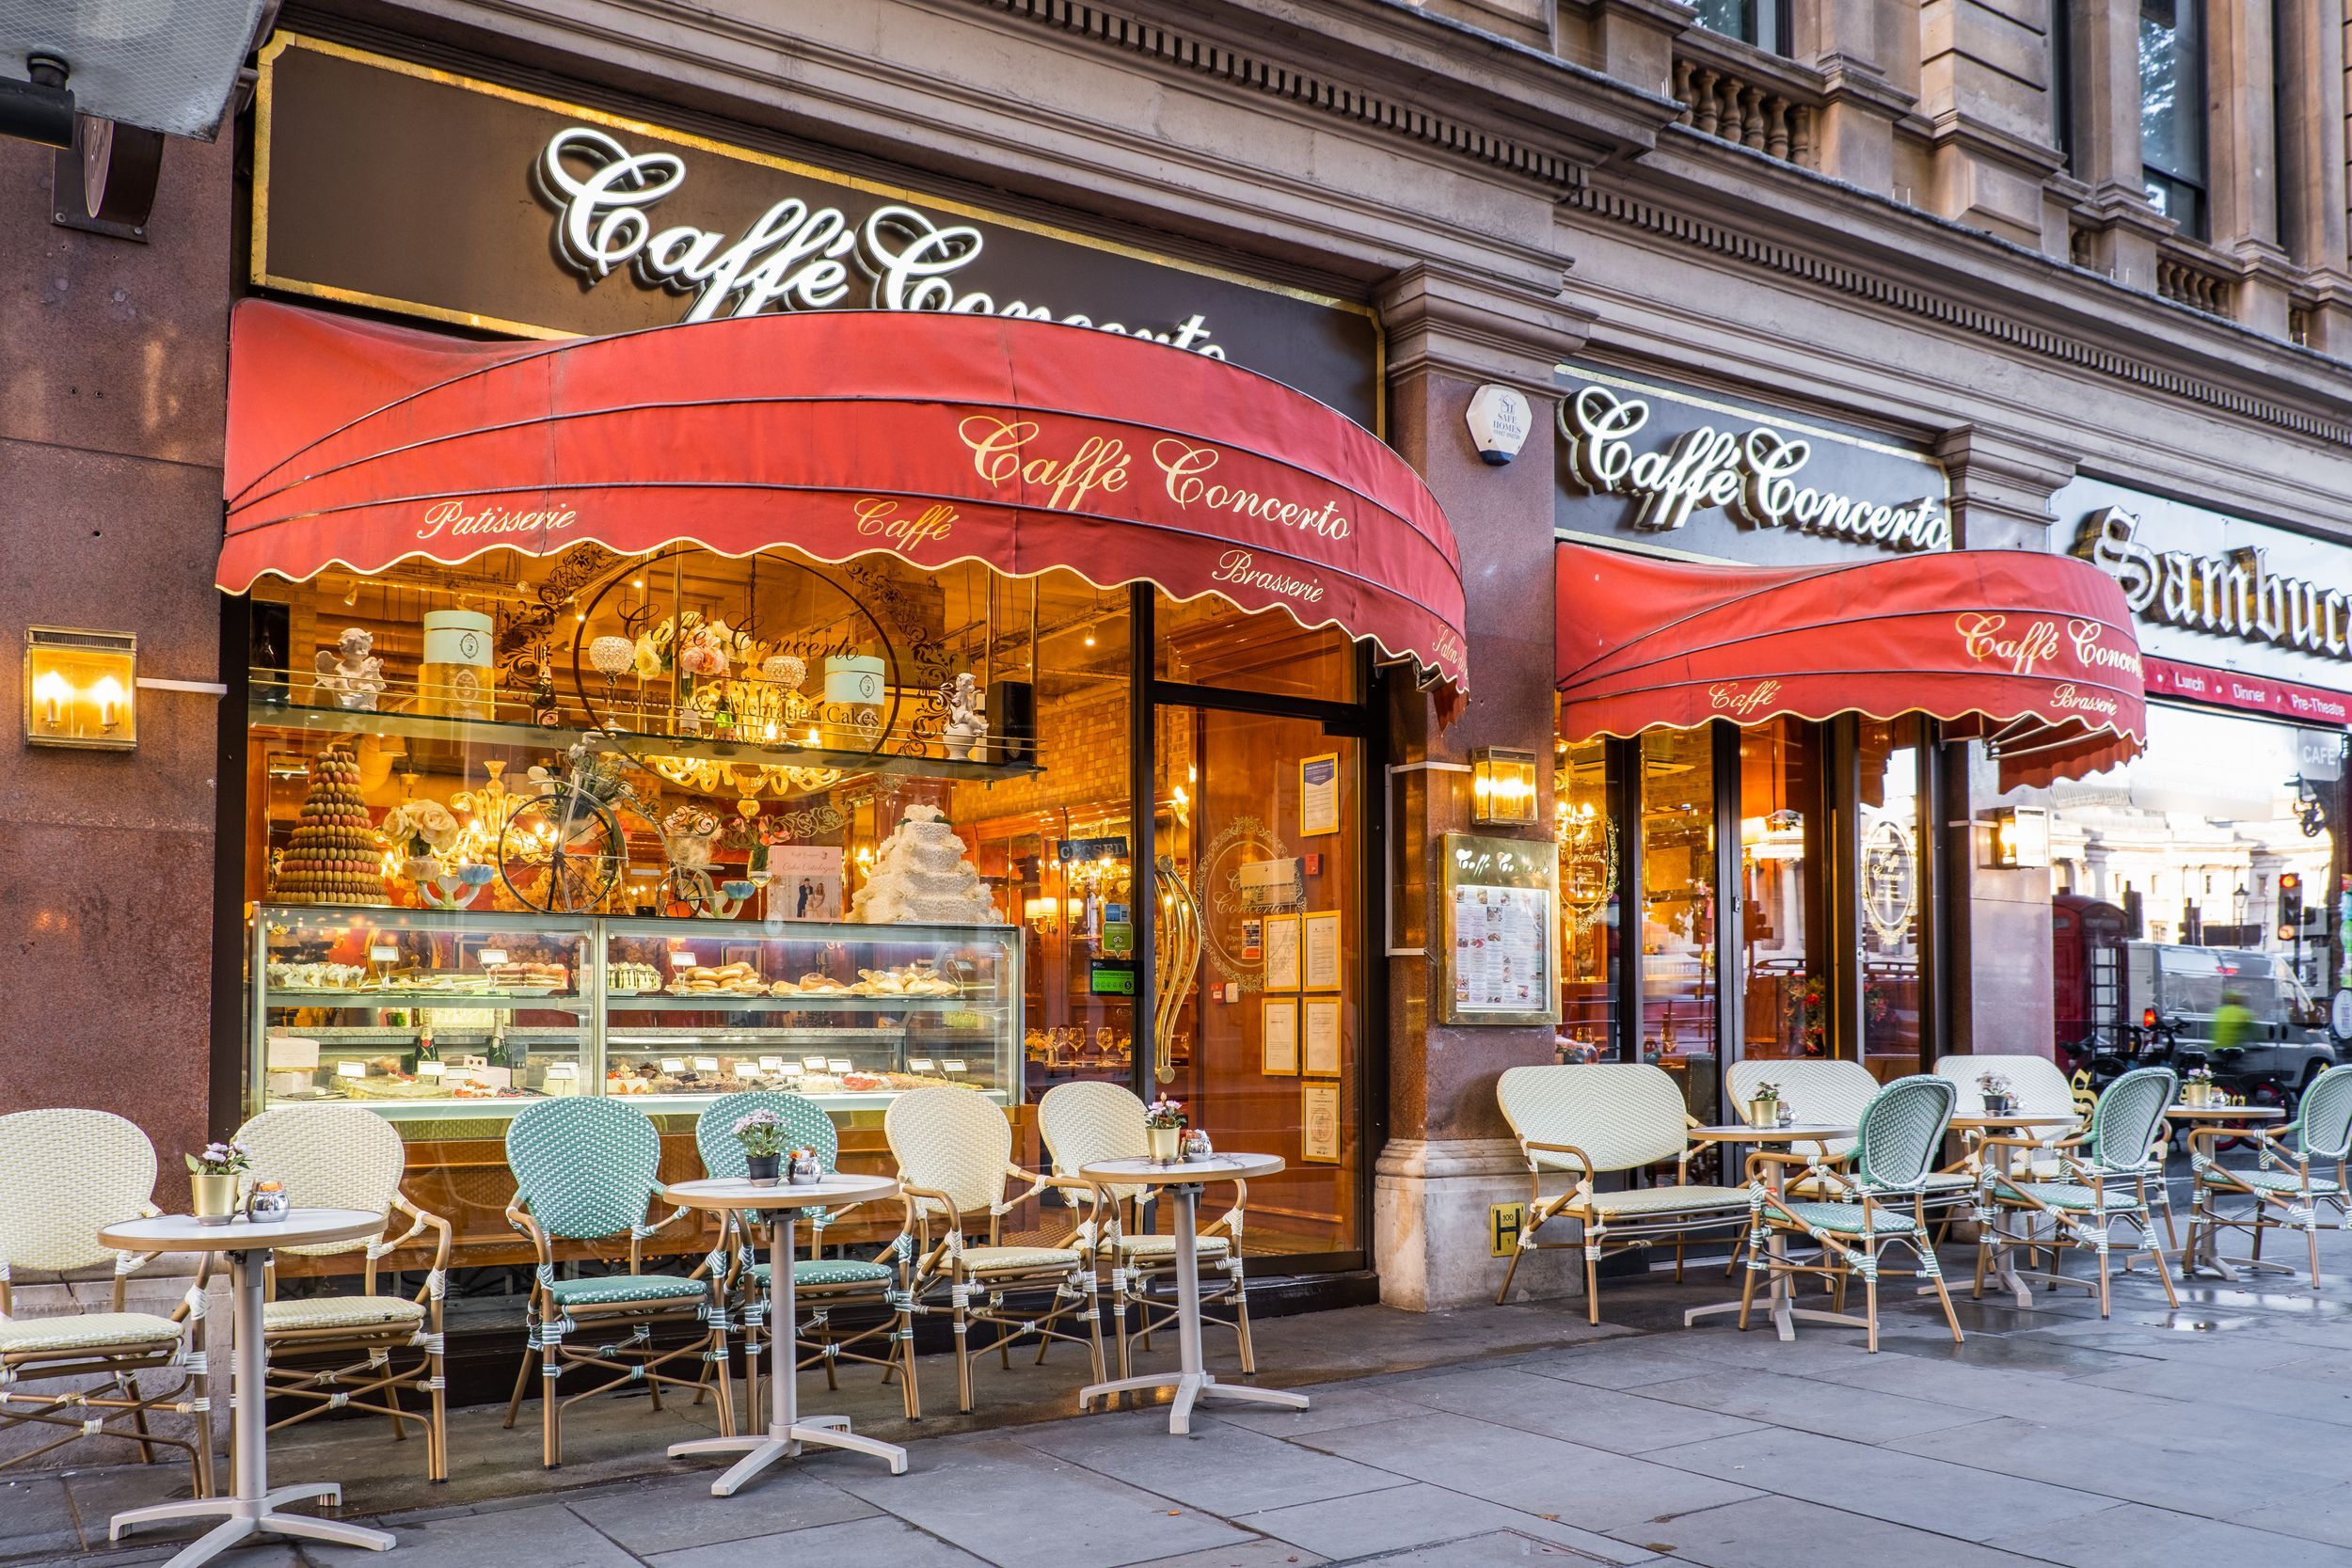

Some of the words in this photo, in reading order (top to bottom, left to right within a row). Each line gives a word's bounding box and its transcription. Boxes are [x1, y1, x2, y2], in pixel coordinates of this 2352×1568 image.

[1493, 420, 1521, 434] HOMES
[1498, 413, 1517, 424] SAFE
[958, 415, 1132, 511] Caffé
[1152, 438, 1351, 541] Concerto
[1577, 386, 1741, 528] Caffé
[1745, 426, 1950, 549] Concerto
[417, 500, 577, 539] Patisserie
[854, 498, 960, 551] Caffé
[1212, 549, 1324, 603] Brasserie
[2093, 505, 2352, 657] Sambuc
[723, 611, 861, 661] Concerto
[1955, 611, 2060, 674] Caffé
[1708, 680, 1782, 716] Caffé
[2050, 683, 2118, 716] Brasserie
[2174, 672, 2205, 692] Lunch
[2233, 684, 2265, 703] Dinner
[2291, 693, 2345, 717] Pre-Theatre
[826, 705, 880, 727] Cakes
[2302, 745, 2337, 767] CAFE
[1059, 843, 1124, 859] CLOSED
[1213, 891, 1284, 915] Concerto
[1496, 1208, 1521, 1251] H
[1502, 1213, 1515, 1222] 100
